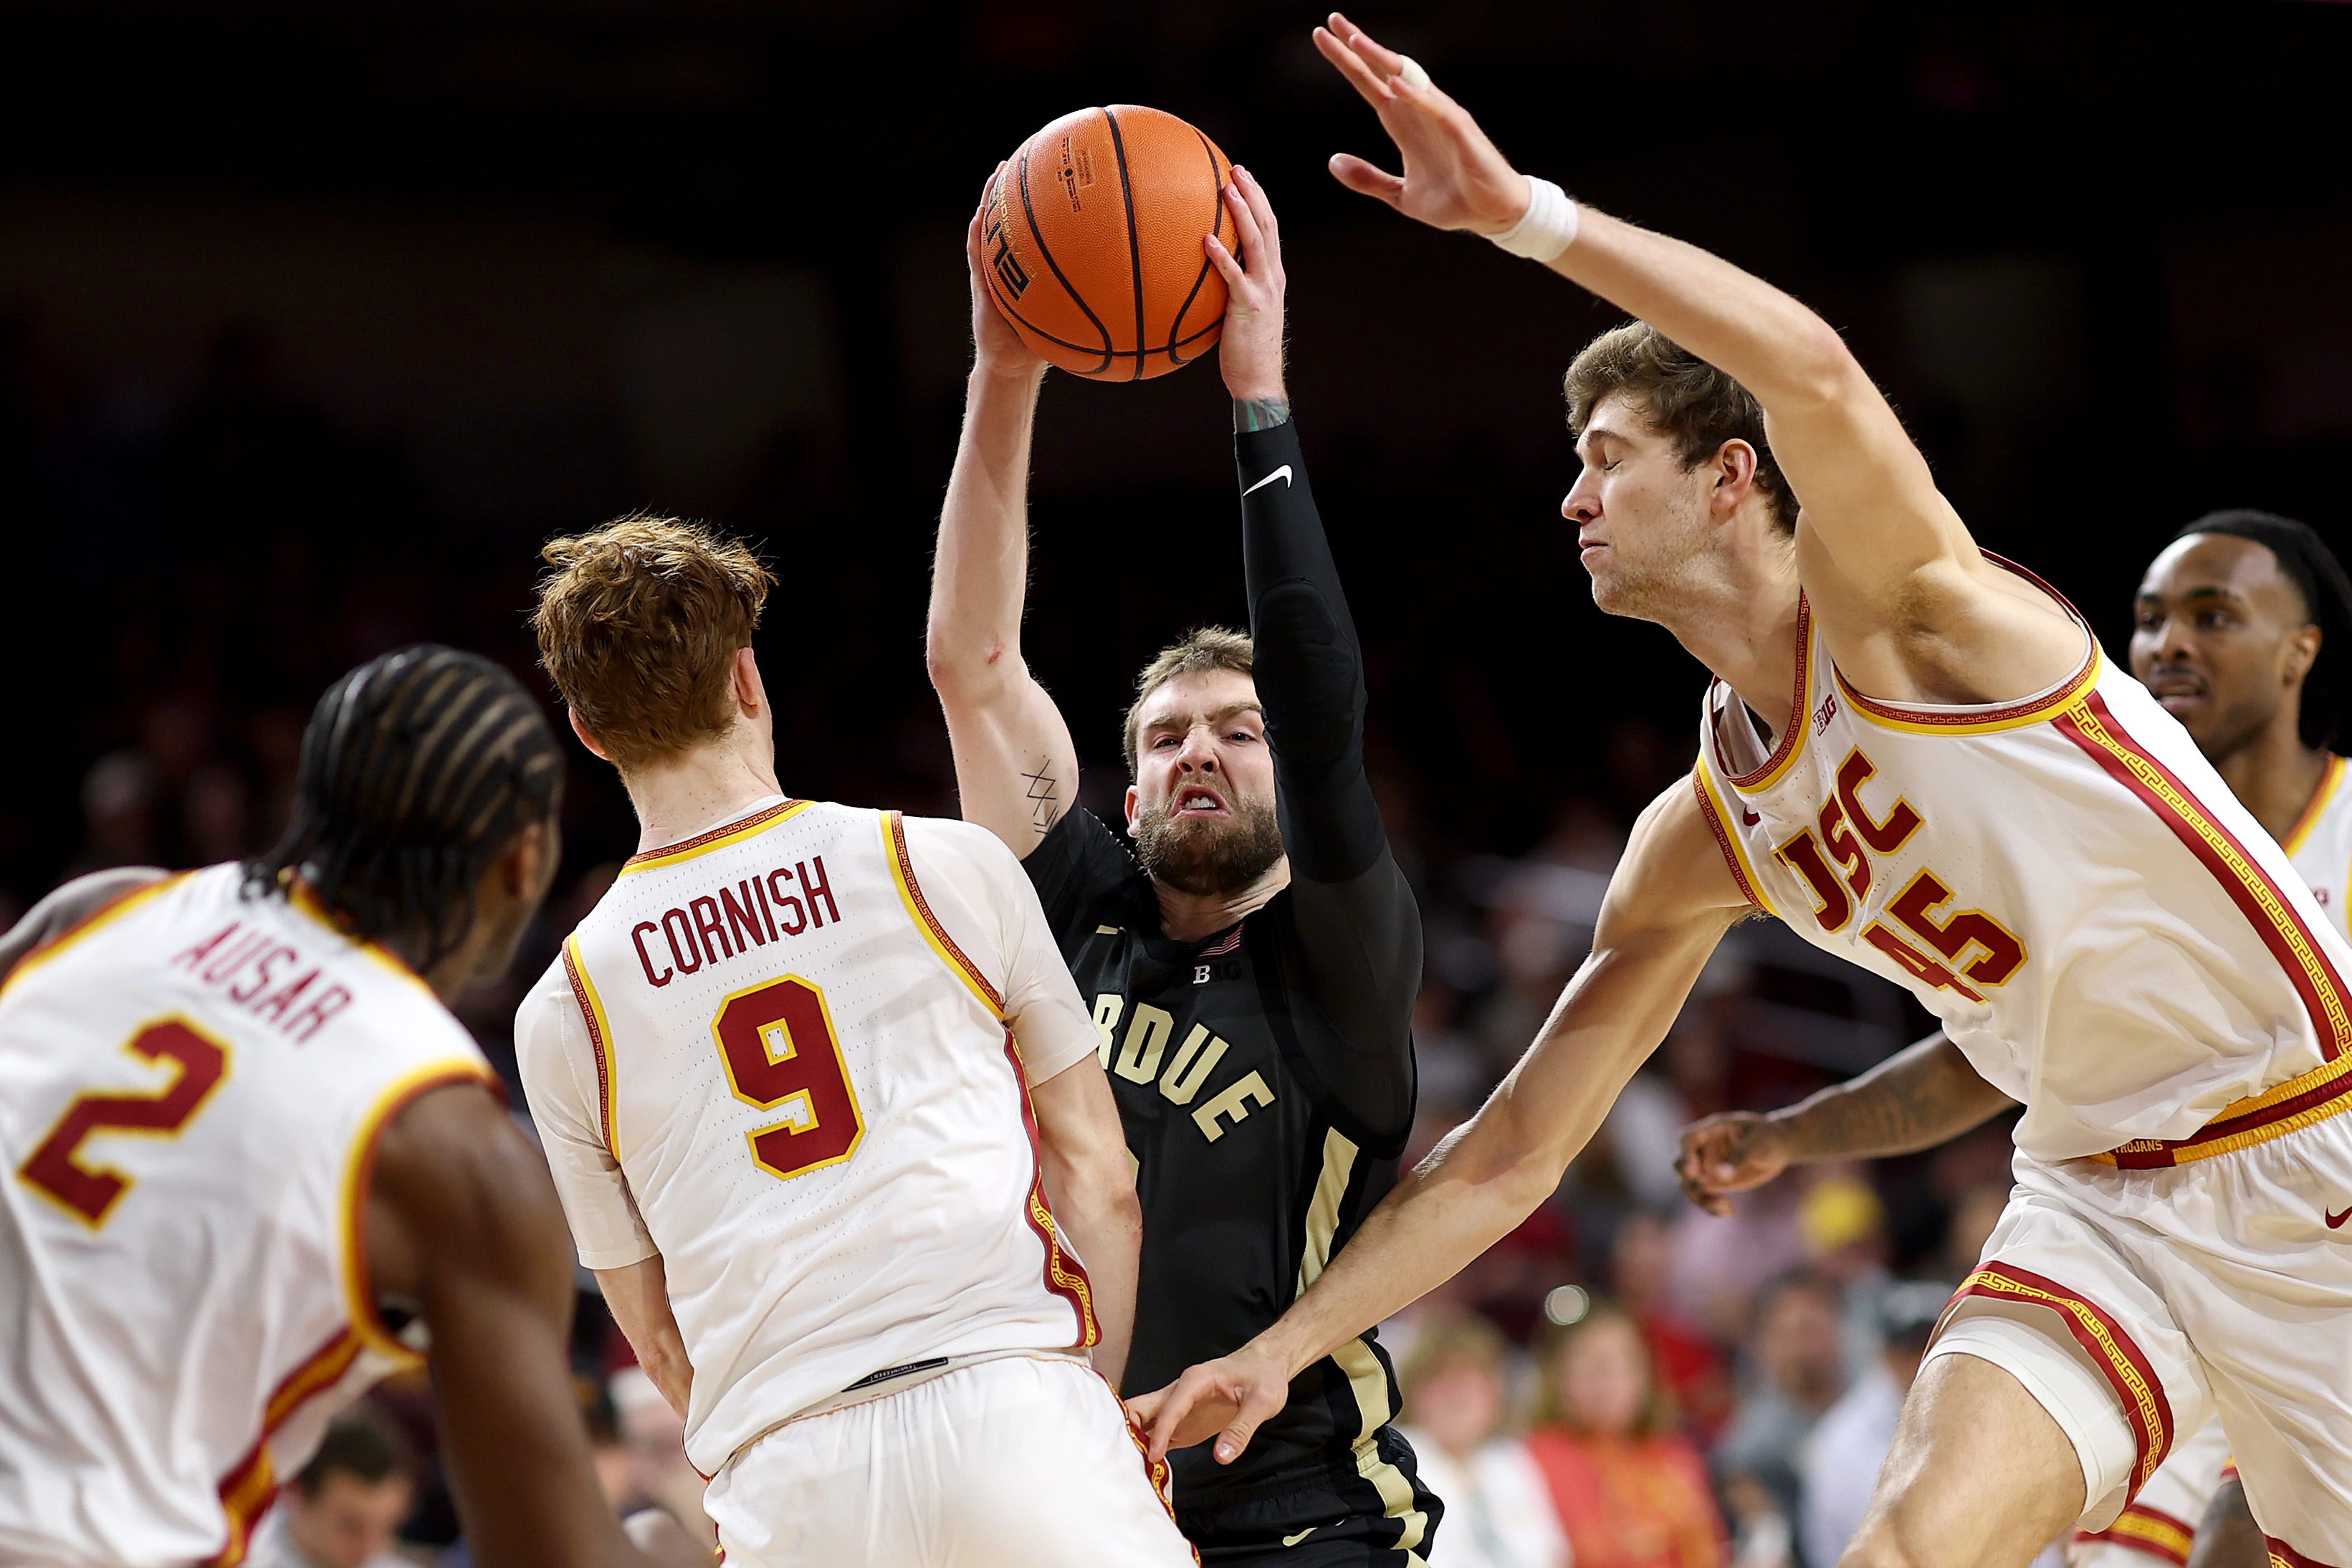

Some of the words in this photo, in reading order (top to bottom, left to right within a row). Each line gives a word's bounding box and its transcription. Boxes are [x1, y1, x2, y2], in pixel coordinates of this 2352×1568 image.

[1771, 745, 1926, 934] USC
[169, 921, 352, 1046] AUSAR
[631, 855, 841, 988] CORNISH
[1860, 866, 2029, 1005] 45
[15, 1012, 233, 1233] 2
[710, 972, 867, 1181] 9
[1093, 993, 1276, 1143] RDUE
